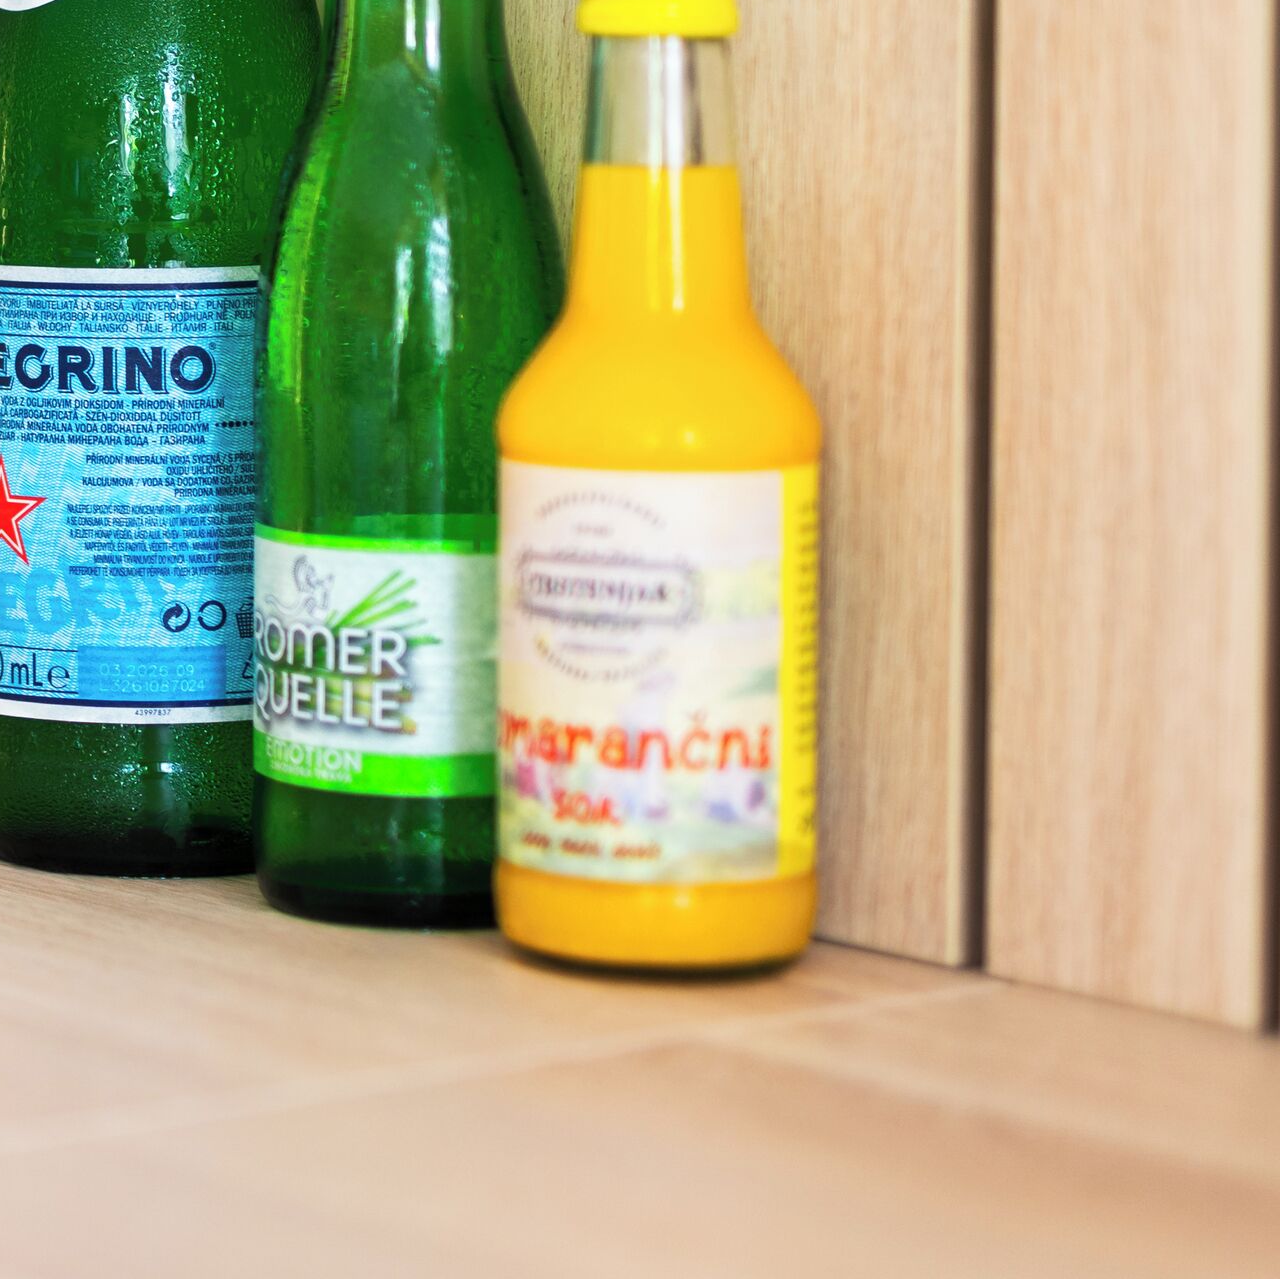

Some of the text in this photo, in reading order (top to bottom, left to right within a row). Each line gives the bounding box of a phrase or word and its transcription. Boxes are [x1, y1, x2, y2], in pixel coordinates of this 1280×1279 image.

[82, 301, 91, 310] LA
[60, 311, 89, 321] ИЗВОР
[92, 312, 99, 321] И
[80, 323, 129, 333] TALIANSKO
[20, 397, 26, 407] Z
[75, 399, 124, 409] DIOKSIDOM
[75, 423, 97, 433] VODA
[125, 435, 148, 447] ВОДА
[160, 435, 205, 445] ГАЗИРАНА
[169, 455, 190, 465] VODA
[142, 477, 163, 487] VODA
[165, 477, 175, 487] SA
[178, 476, 218, 487] DODATKOM
[174, 487, 214, 497] PRIRODNA
[10, 652, 43, 687] mL
